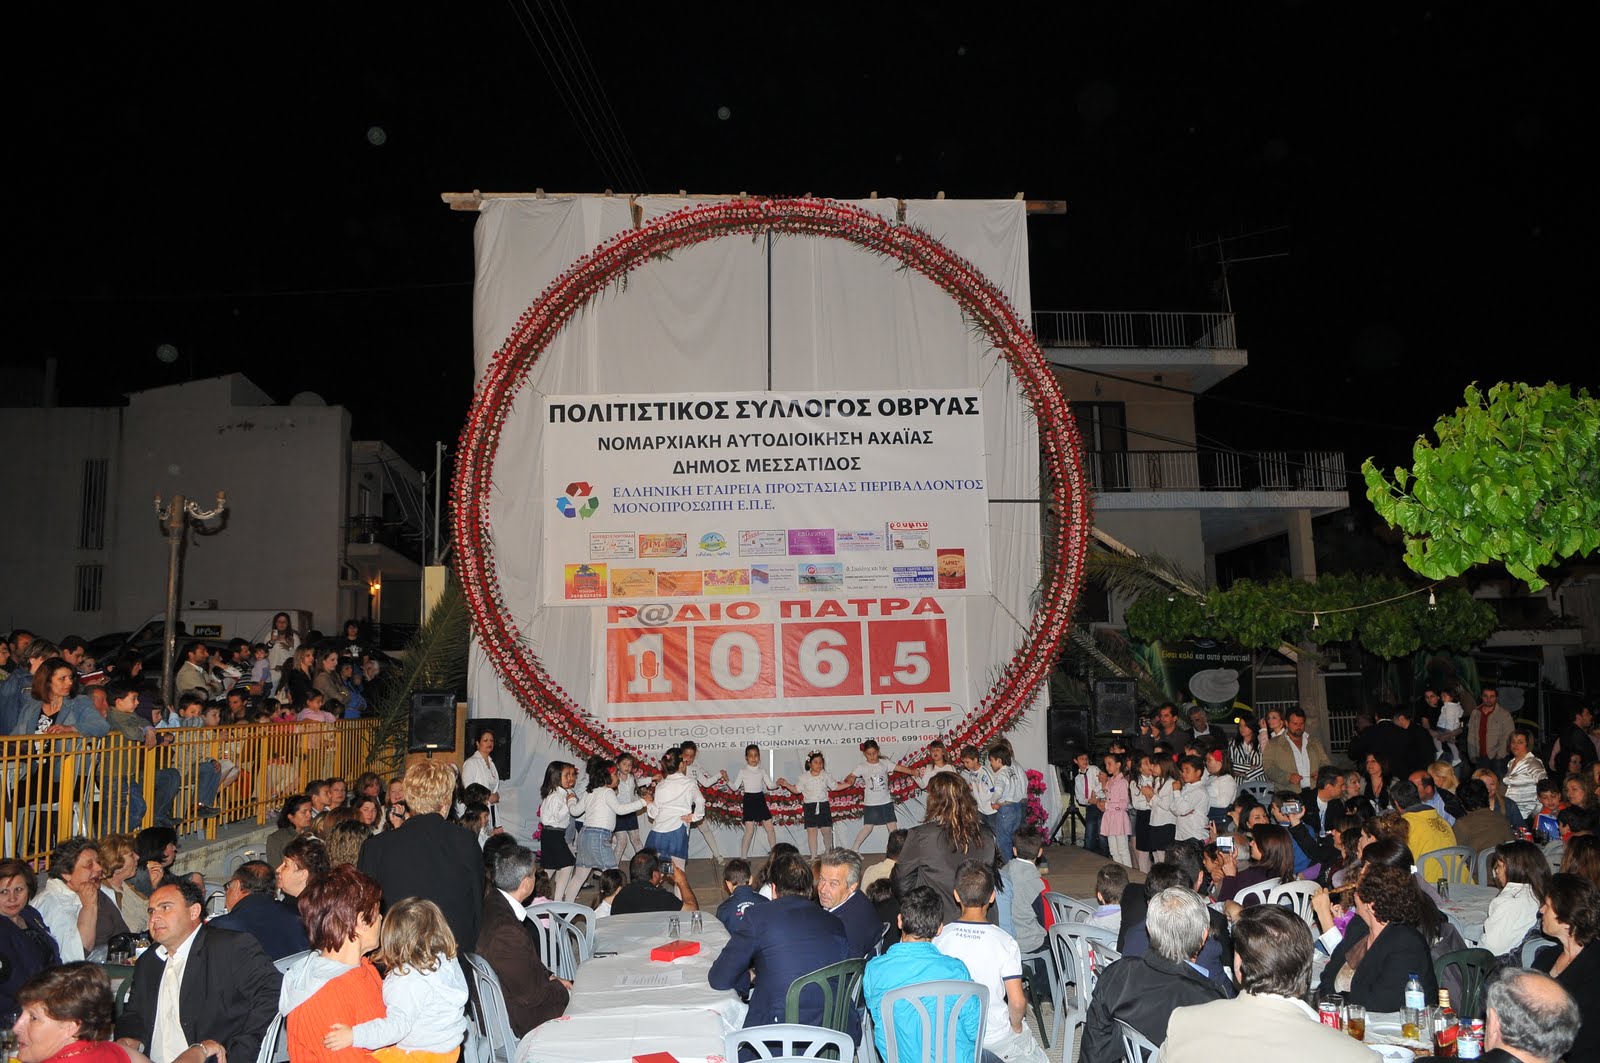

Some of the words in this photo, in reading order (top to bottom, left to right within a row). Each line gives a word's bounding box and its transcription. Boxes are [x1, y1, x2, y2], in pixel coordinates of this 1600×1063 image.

[549, 400, 730, 424] ΠΟΛΙΤΙΣΤΙΚΟΣ
[735, 398, 872, 420] ΣΥΛΛΟΓΟΣ
[877, 396, 980, 417] ΟΒΡΥΑΣ
[598, 434, 722, 451] ΝΟΜΑΡΧΙΑΚΗ
[726, 431, 863, 449] ΑΥΤΟΔΙΟΙΚΗΣΗ
[867, 427, 934, 446] ΑΧΑΪΑΣ
[672, 458, 741, 475] ΔΗΜΟΣ
[745, 456, 862, 473] ΜΕΣΣΑΤΙΔΟΣ
[612, 485, 692, 498] ΕΛΛΗΝΙΚΗ
[696, 484, 762, 496] ΕΤΑΙΡΕΙΑ
[765, 482, 857, 494] ΠΡΟΣΤΑΣΙΑΣ
[860, 479, 984, 492] ΠΕΡΙΒΑΛΛΟΝΤΟΣ
[612, 500, 733, 514] ΜΟΝΟΠΡΟΣΩΠΗ
[737, 499, 775, 511] Ε.Π.Ε.
[780, 597, 946, 618] ΠΑΤΡΑ
[880, 700, 914, 715] FM
[612, 723, 783, 739] adiopatra@otenet.gr
[804, 718, 952, 732] www.radiopatra.gr
[956, 932, 981, 940] FASHION
